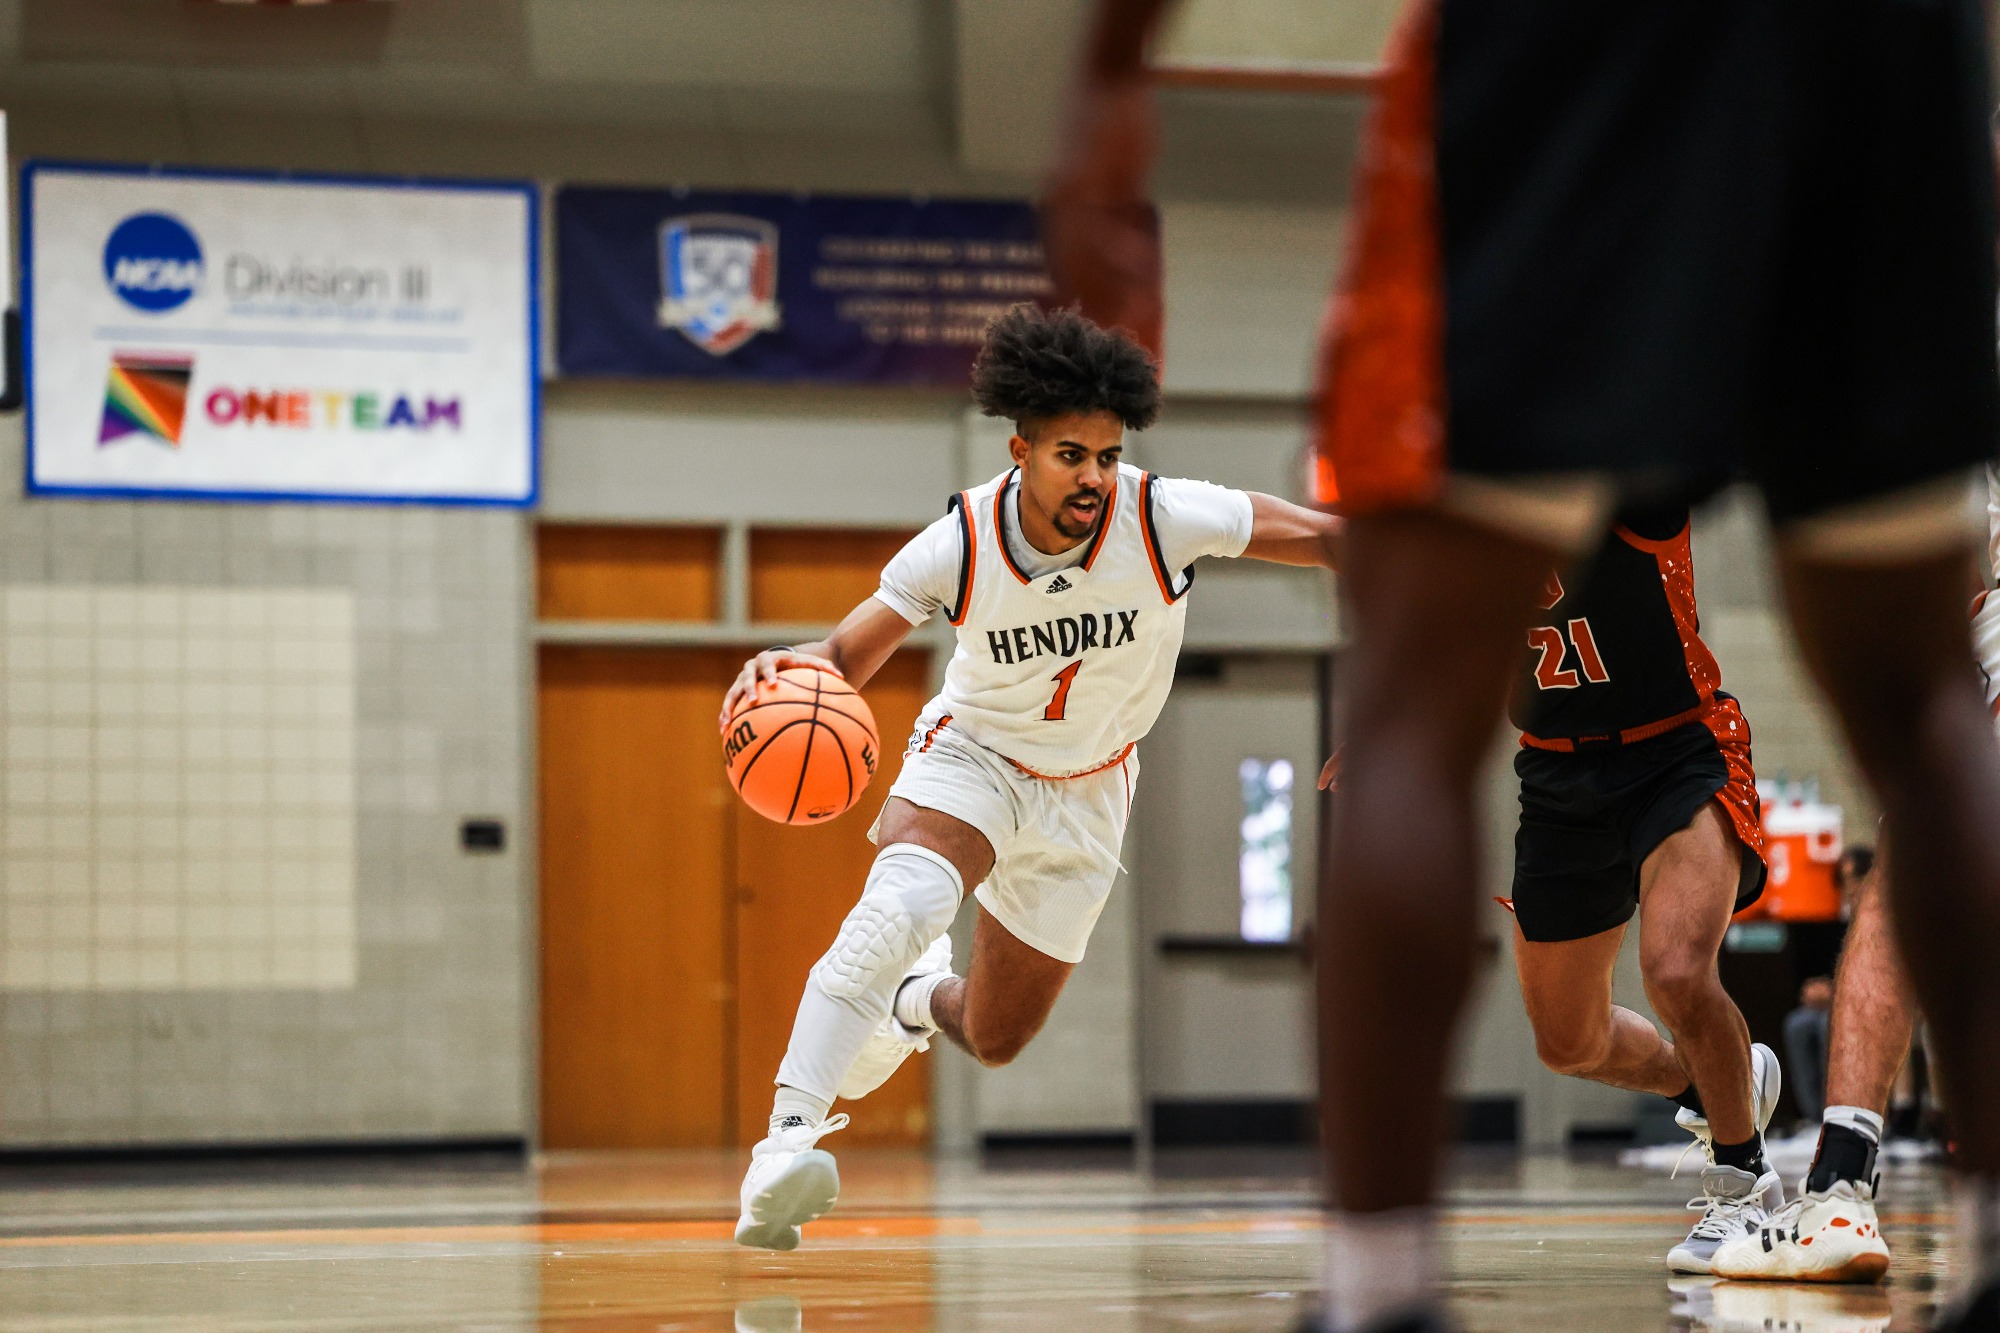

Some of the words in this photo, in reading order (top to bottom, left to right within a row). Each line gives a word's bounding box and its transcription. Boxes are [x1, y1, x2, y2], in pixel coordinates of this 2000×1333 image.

[112, 256, 204, 293] NCAA
[224, 253, 391, 302] Division
[205, 387, 463, 431] ONETEAM
[1045, 582, 1073, 594] adidas
[986, 609, 1139, 665] HENDRIX
[1527, 616, 1611, 690] 21
[1035, 659, 1083, 721] 1
